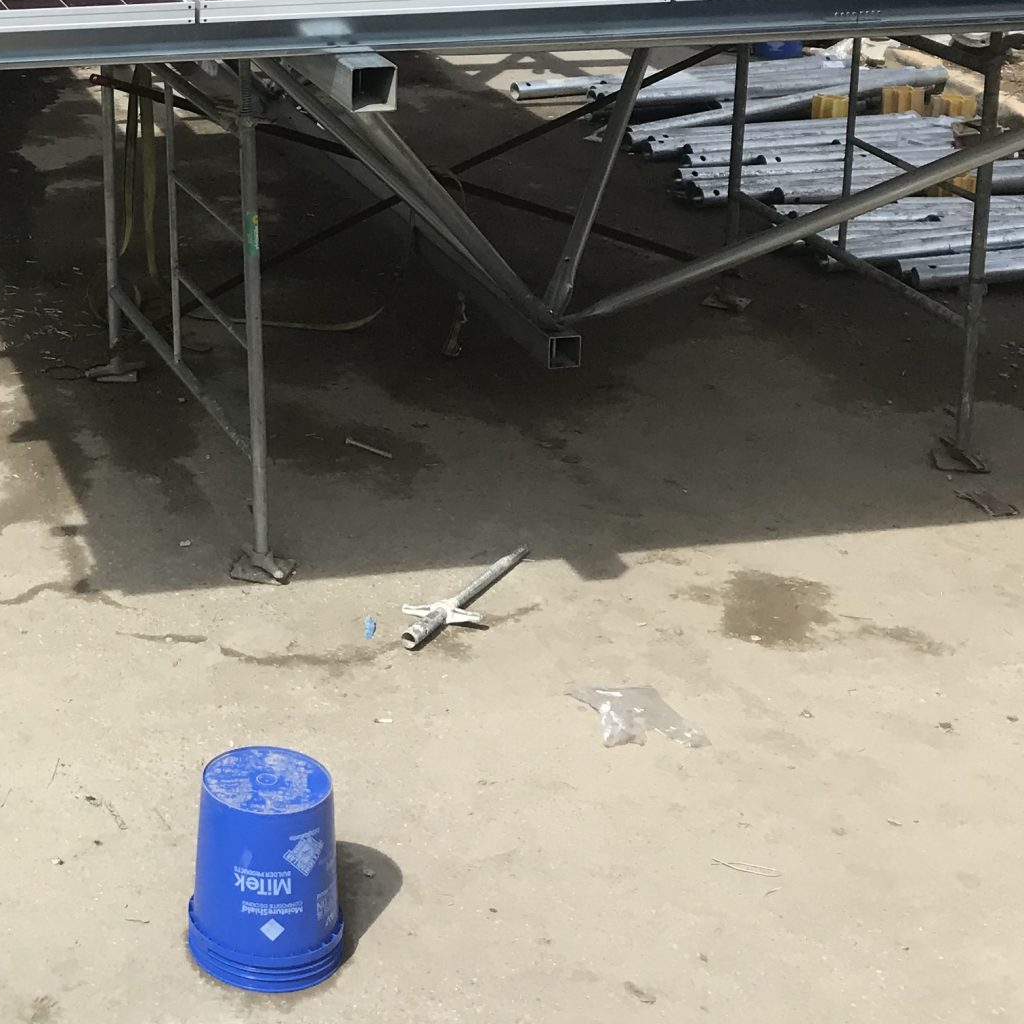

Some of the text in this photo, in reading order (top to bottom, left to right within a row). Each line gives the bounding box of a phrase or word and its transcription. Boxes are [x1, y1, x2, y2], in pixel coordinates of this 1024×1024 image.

[234, 866, 264, 877] PRODUCTS
[234, 873, 292, 895] MiTek
[241, 905, 303, 916] MoistureShield
